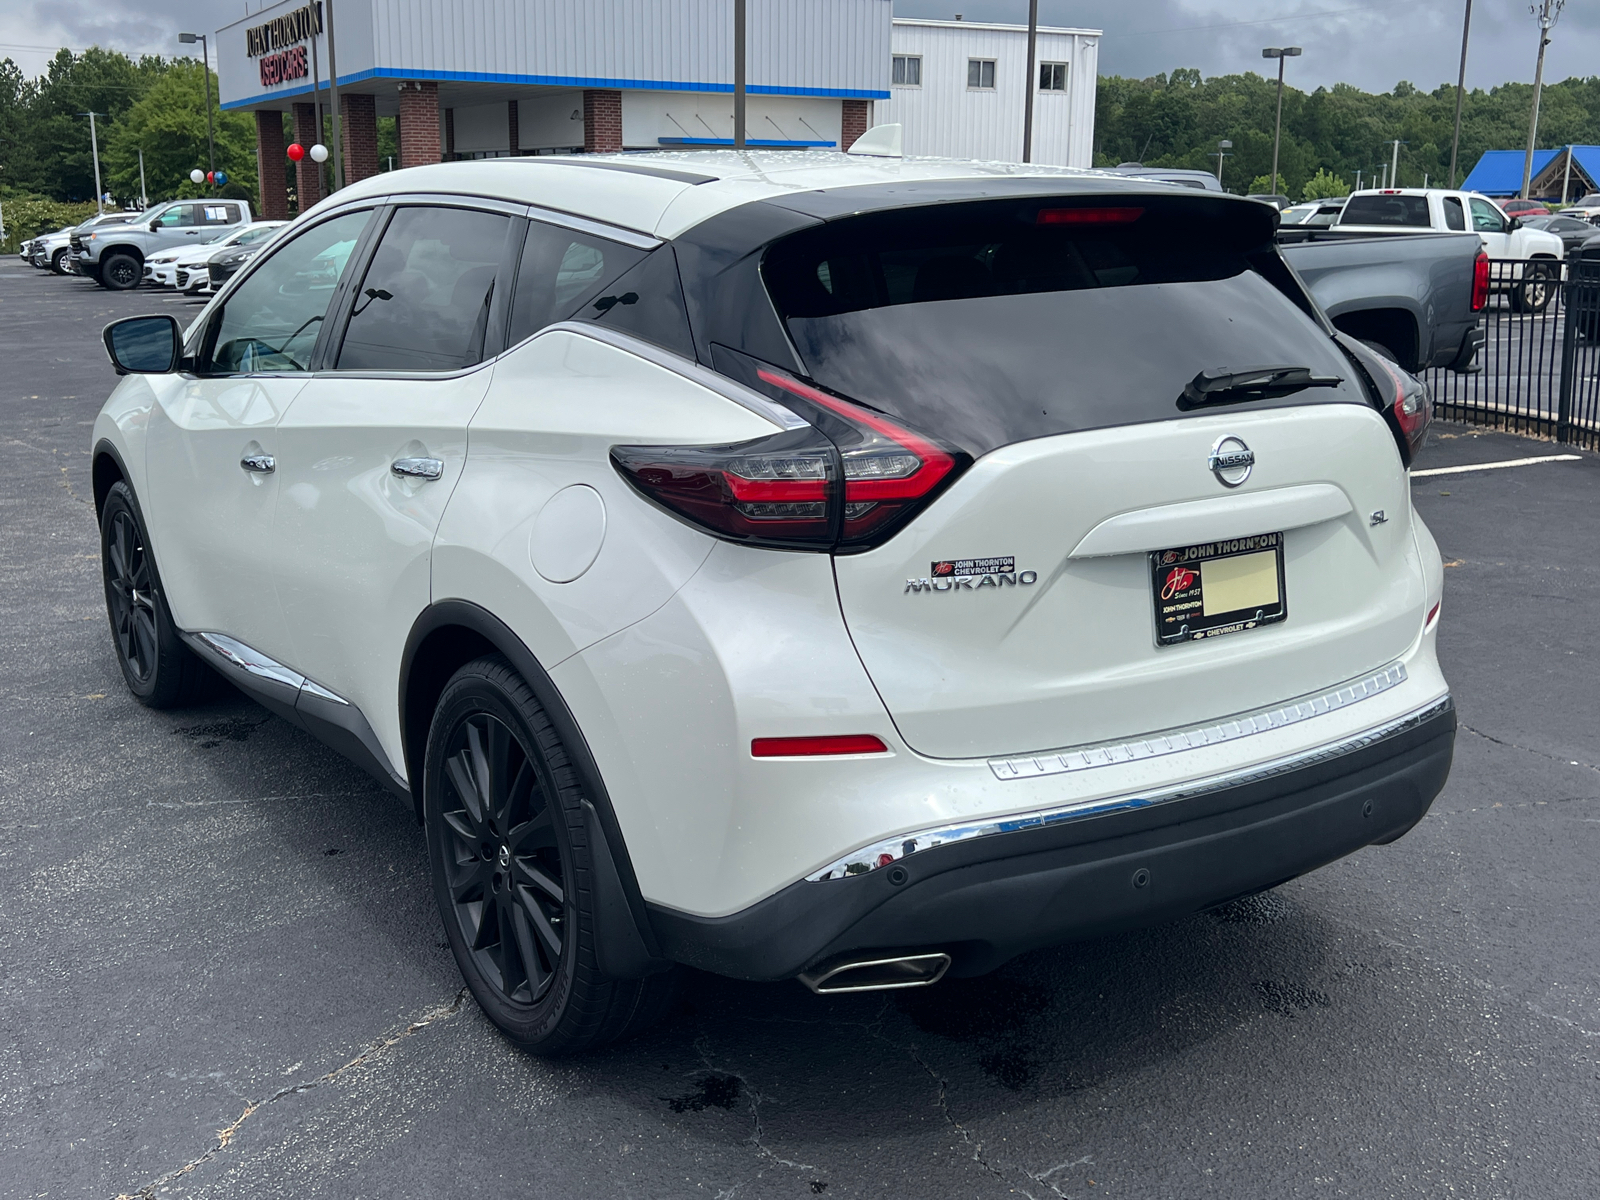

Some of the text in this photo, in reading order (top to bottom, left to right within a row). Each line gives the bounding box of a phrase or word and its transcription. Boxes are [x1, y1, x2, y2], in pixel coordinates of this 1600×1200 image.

[246, 1, 323, 57] JOHN THORNTON
[260, 45, 308, 86] USED CARS
[1216, 453, 1253, 467] NISSAN
[1369, 510, 1389, 527] SL
[1184, 533, 1277, 560] JOHN THORNTON
[955, 557, 1013, 568] JOHN THORNTON
[954, 566, 1000, 576] CHEVROLET
[904, 570, 1038, 593] MURANO
[1188, 588, 1201, 597] 1957
[1163, 600, 1202, 613] JOHN THORNTON
[1206, 623, 1244, 637] CHEVROLET
